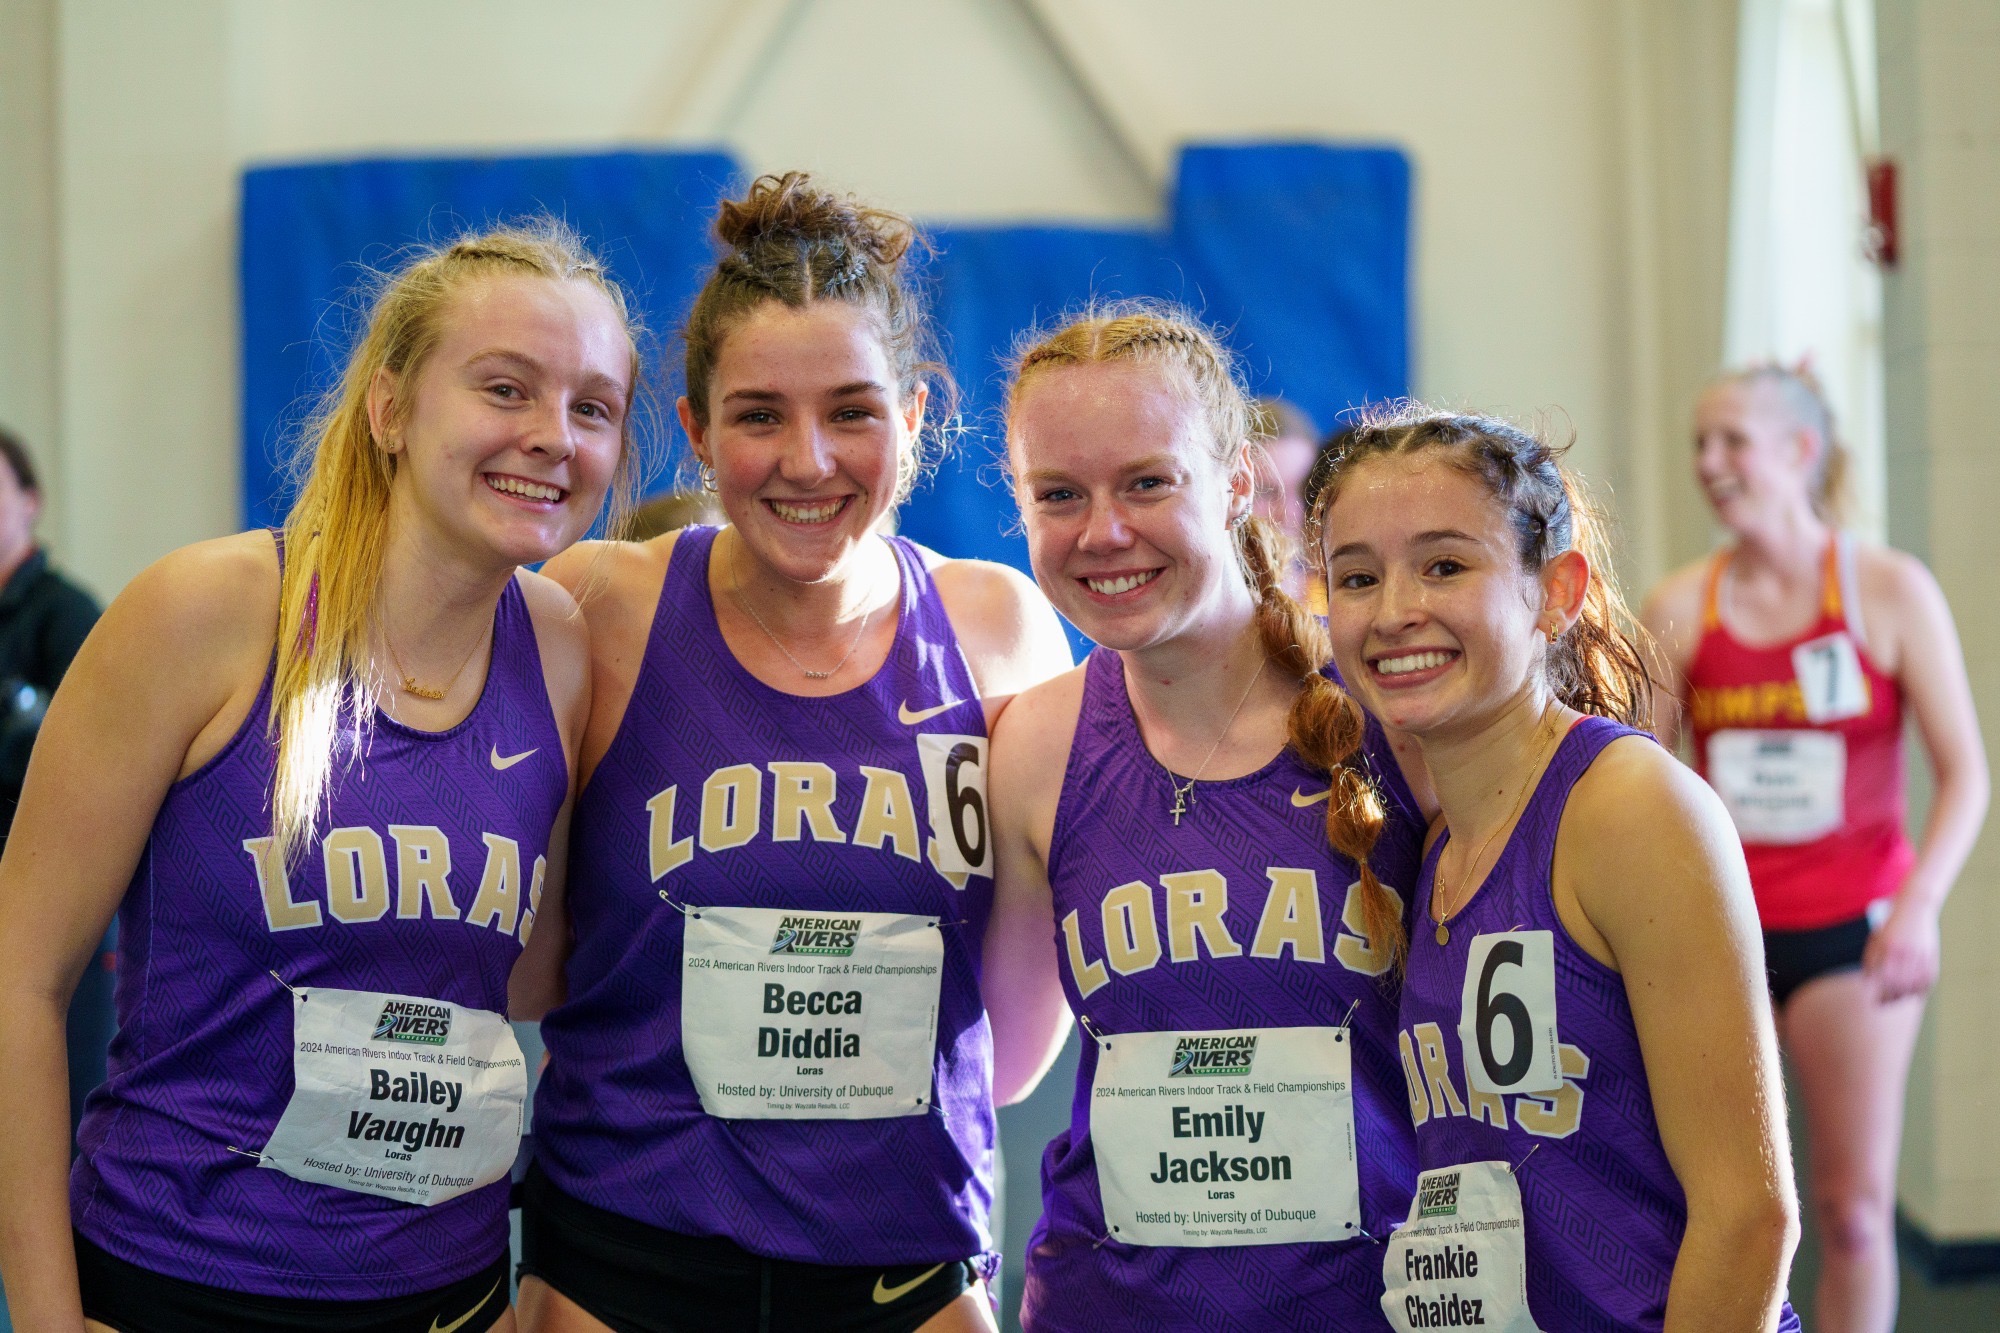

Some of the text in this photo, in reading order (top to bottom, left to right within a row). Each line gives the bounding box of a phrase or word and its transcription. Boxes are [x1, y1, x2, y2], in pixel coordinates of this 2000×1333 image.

[945, 742, 986, 868] 6
[779, 917, 861, 931] AMERICAN
[1062, 867, 1404, 1000] LORAS
[772, 929, 857, 953] RIVERS
[688, 957, 937, 976] 2024 American Rivers Indoor Track & Field Championships
[383, 1002, 450, 1019] AMERICAN
[762, 982, 862, 1016] Becca
[1475, 940, 1534, 1087] 6
[374, 1014, 449, 1039] RIVERS
[757, 1026, 860, 1059] Diddia
[1176, 1036, 1257, 1050] AMERICAN
[300, 1041, 520, 1070] 2024 American Rivers Indoor Track & Field Championships
[1171, 1050, 1253, 1076] RIVERS
[796, 1066, 824, 1076] Loras
[369, 1068, 462, 1113] Bailey
[717, 1083, 894, 1100] Hosted by: University of Dubuque
[1096, 1081, 1346, 1097] 2024 American Rivers Indoor Track & Field Championships
[767, 1102, 784, 1110] Timing
[795, 1102, 817, 1110] Wayzata
[347, 1110, 465, 1152] Vaughn
[1172, 1104, 1265, 1143] Emily
[385, 1149, 413, 1161] Loras
[1150, 1150, 1292, 1184] Jackson
[303, 1157, 474, 1188] Hosted by: University of Dubuque
[1421, 1173, 1460, 1191] AMERICAN
[1208, 1190, 1235, 1200] Loras
[1135, 1208, 1316, 1226] Hosted by: University of Dubuque
[1438, 1224, 1453, 1235] Track
[1454, 1224, 1460, 1233] &
[1460, 1222, 1474, 1233] Field
[1475, 1218, 1520, 1232] Championships
[1182, 1229, 1200, 1237] Timing
[1210, 1228, 1233, 1236] Wayzata
[1405, 1244, 1478, 1282] Frankie
[1405, 1293, 1485, 1328] Chaidez
